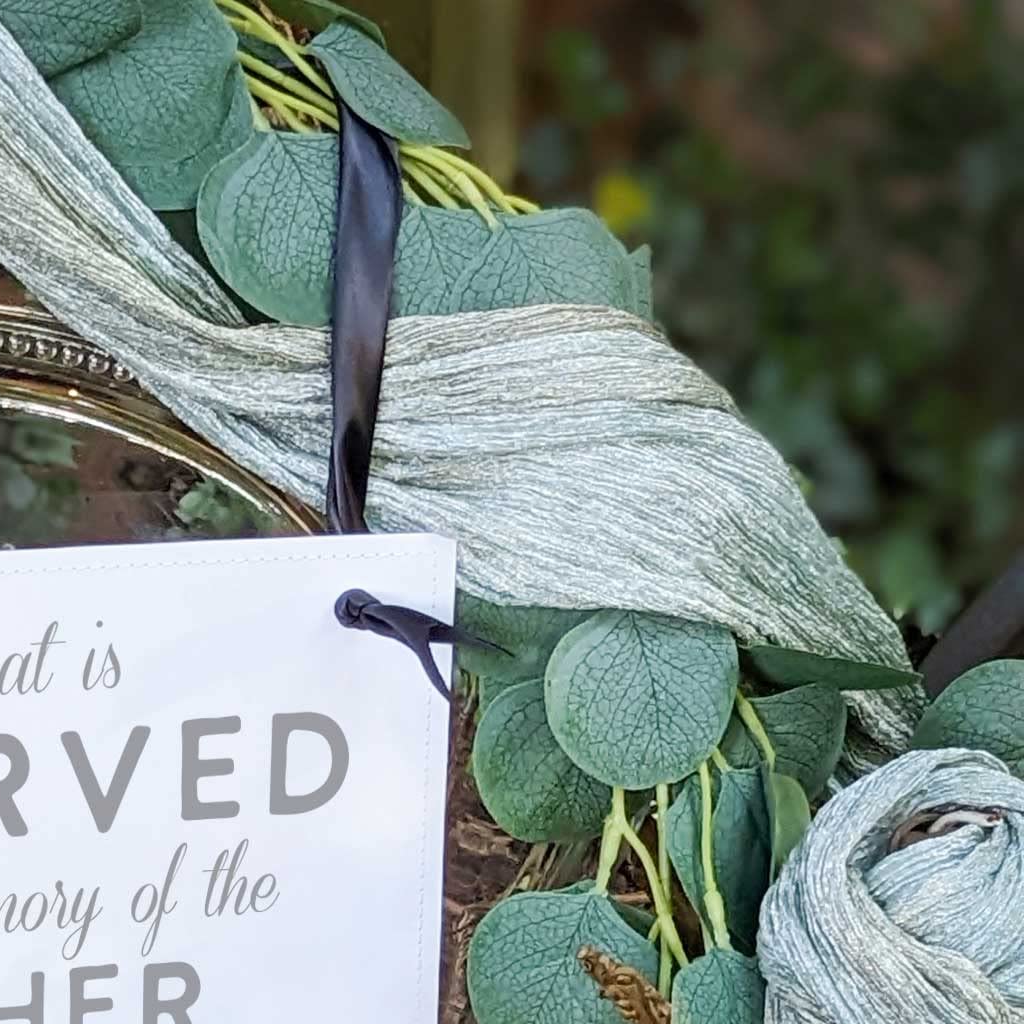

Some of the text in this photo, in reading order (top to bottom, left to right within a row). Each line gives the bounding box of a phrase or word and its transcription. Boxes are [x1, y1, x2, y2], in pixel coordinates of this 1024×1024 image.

[82, 620, 122, 692] is
[130, 842, 188, 958] of
[201, 838, 281, 918] the
